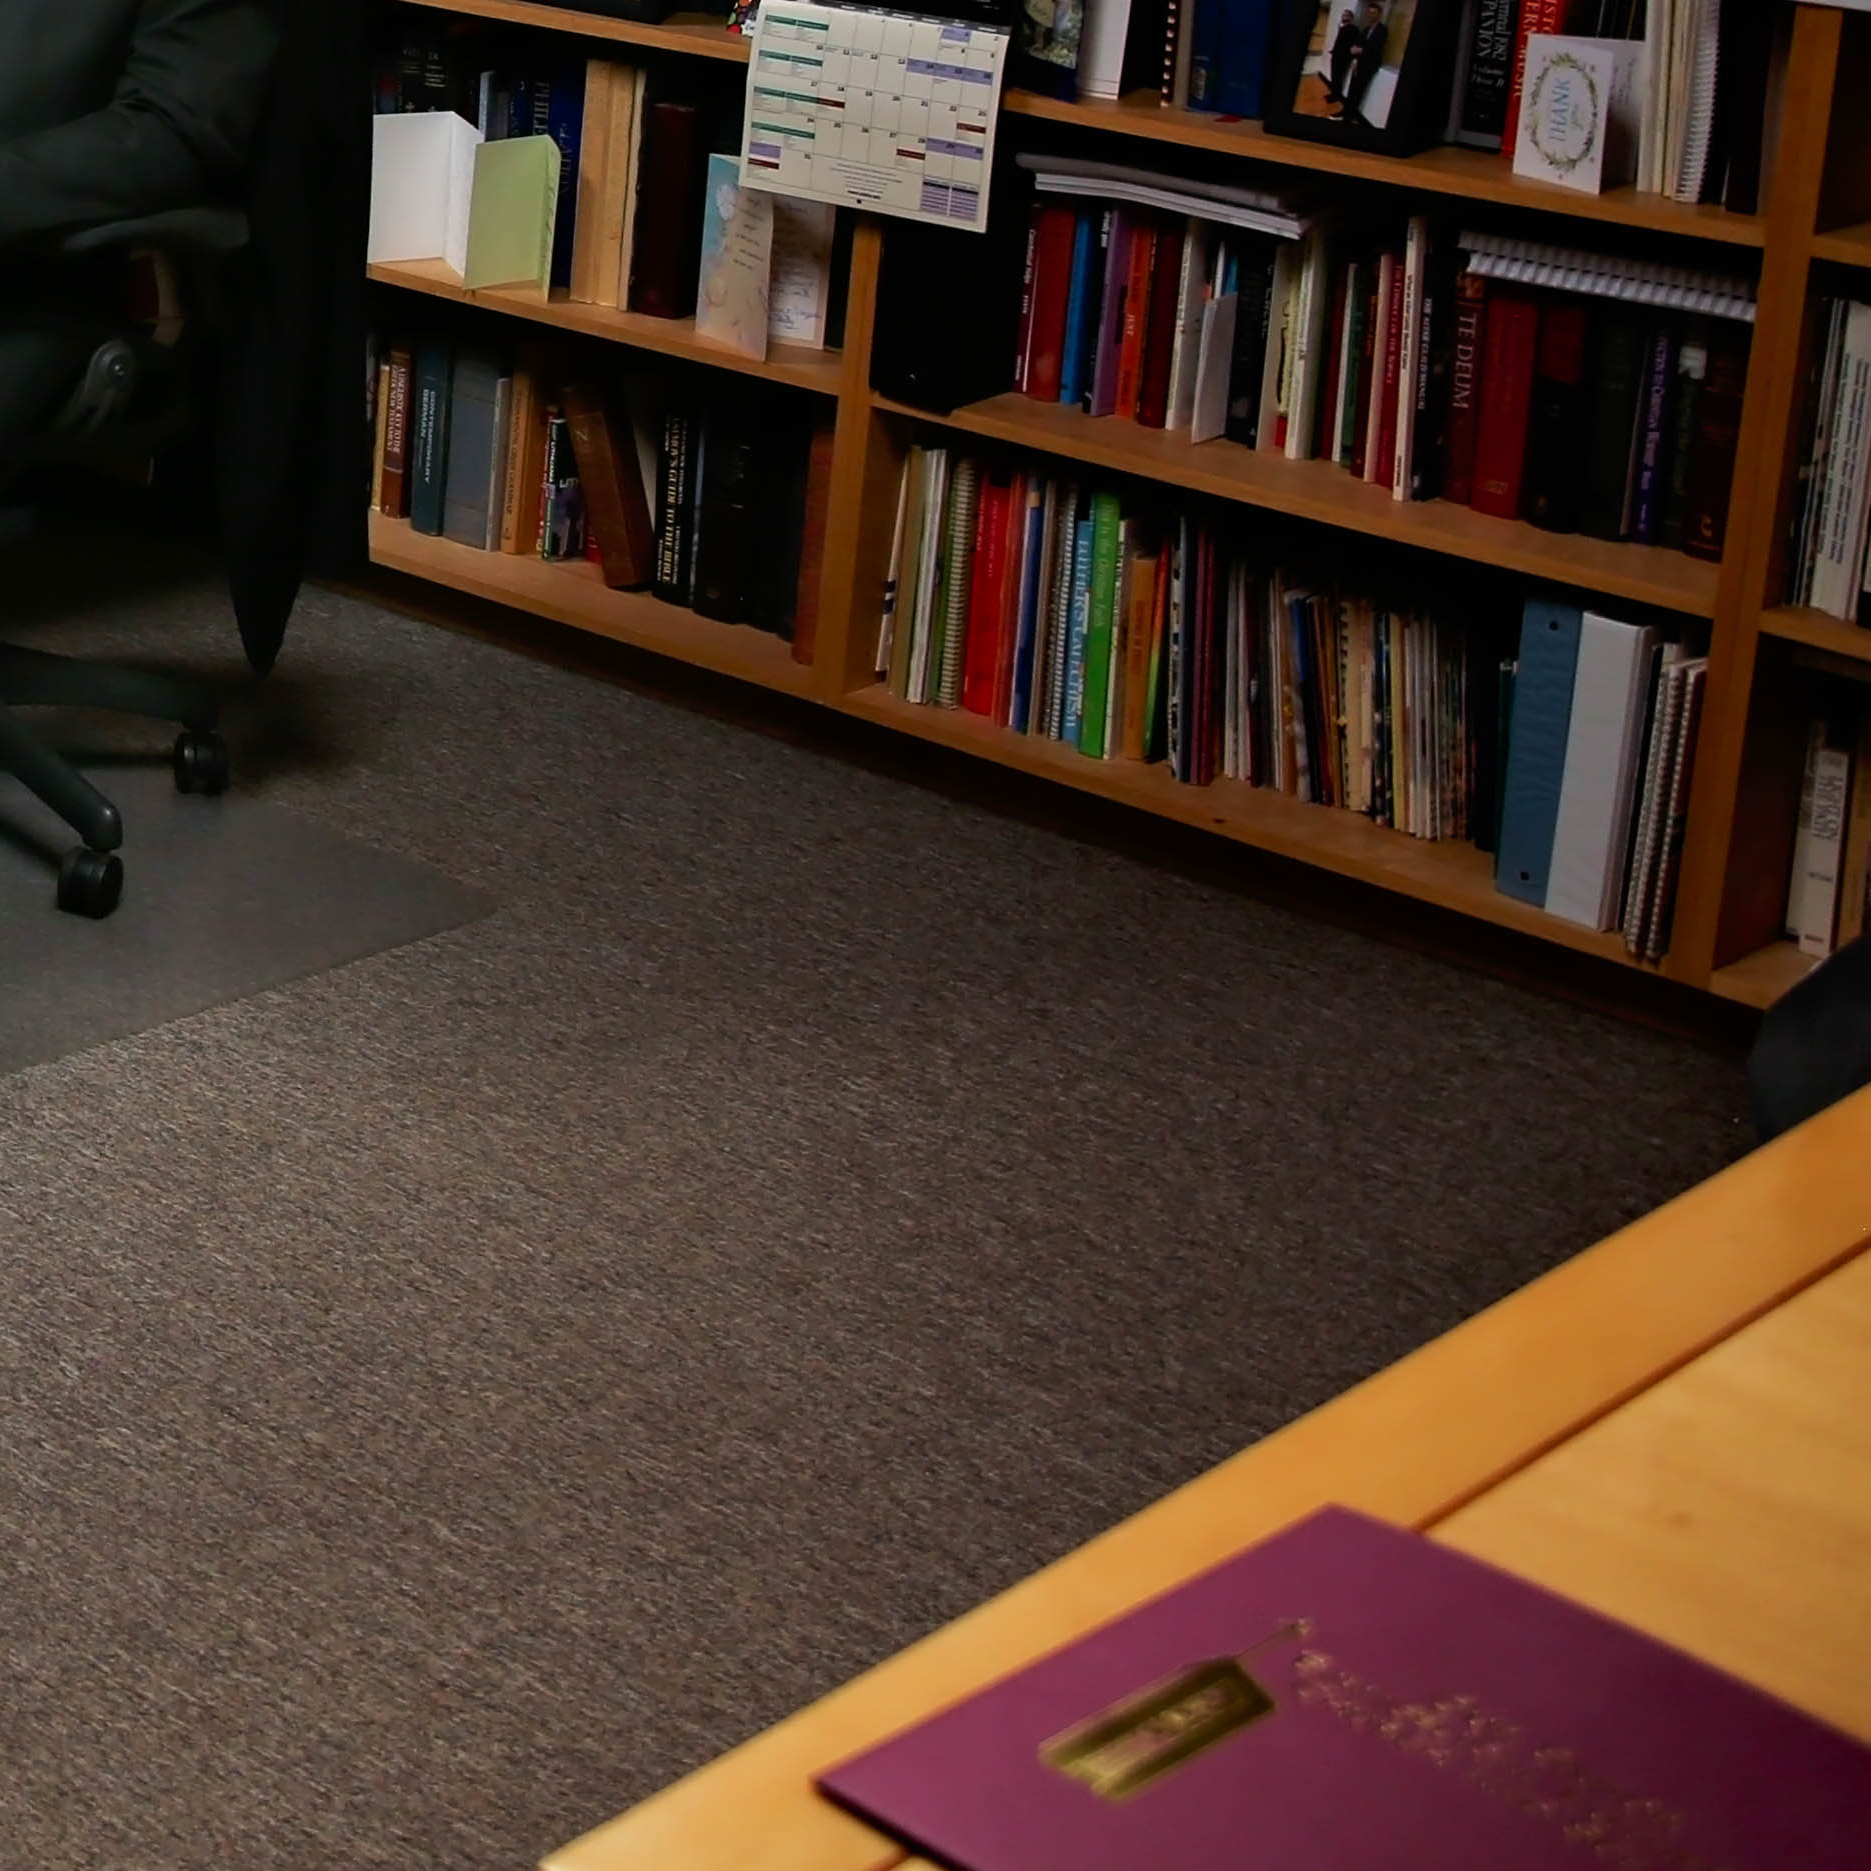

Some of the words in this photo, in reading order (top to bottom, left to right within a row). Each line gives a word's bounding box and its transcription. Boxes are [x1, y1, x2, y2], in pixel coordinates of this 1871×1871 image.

[1548, 77, 1570, 142] THANK
[1456, 313, 1477, 338] TE
[1451, 344, 1474, 409] DEUM
[420, 388, 430, 439] GERMAN
[423, 390, 437, 485] CONTEMPORARY
[665, 469, 680, 506] GUIDE
[662, 550, 674, 585] BIBLE
[1072, 540, 1092, 621] LUTHER'S
[1065, 627, 1088, 728] CATECHISM
